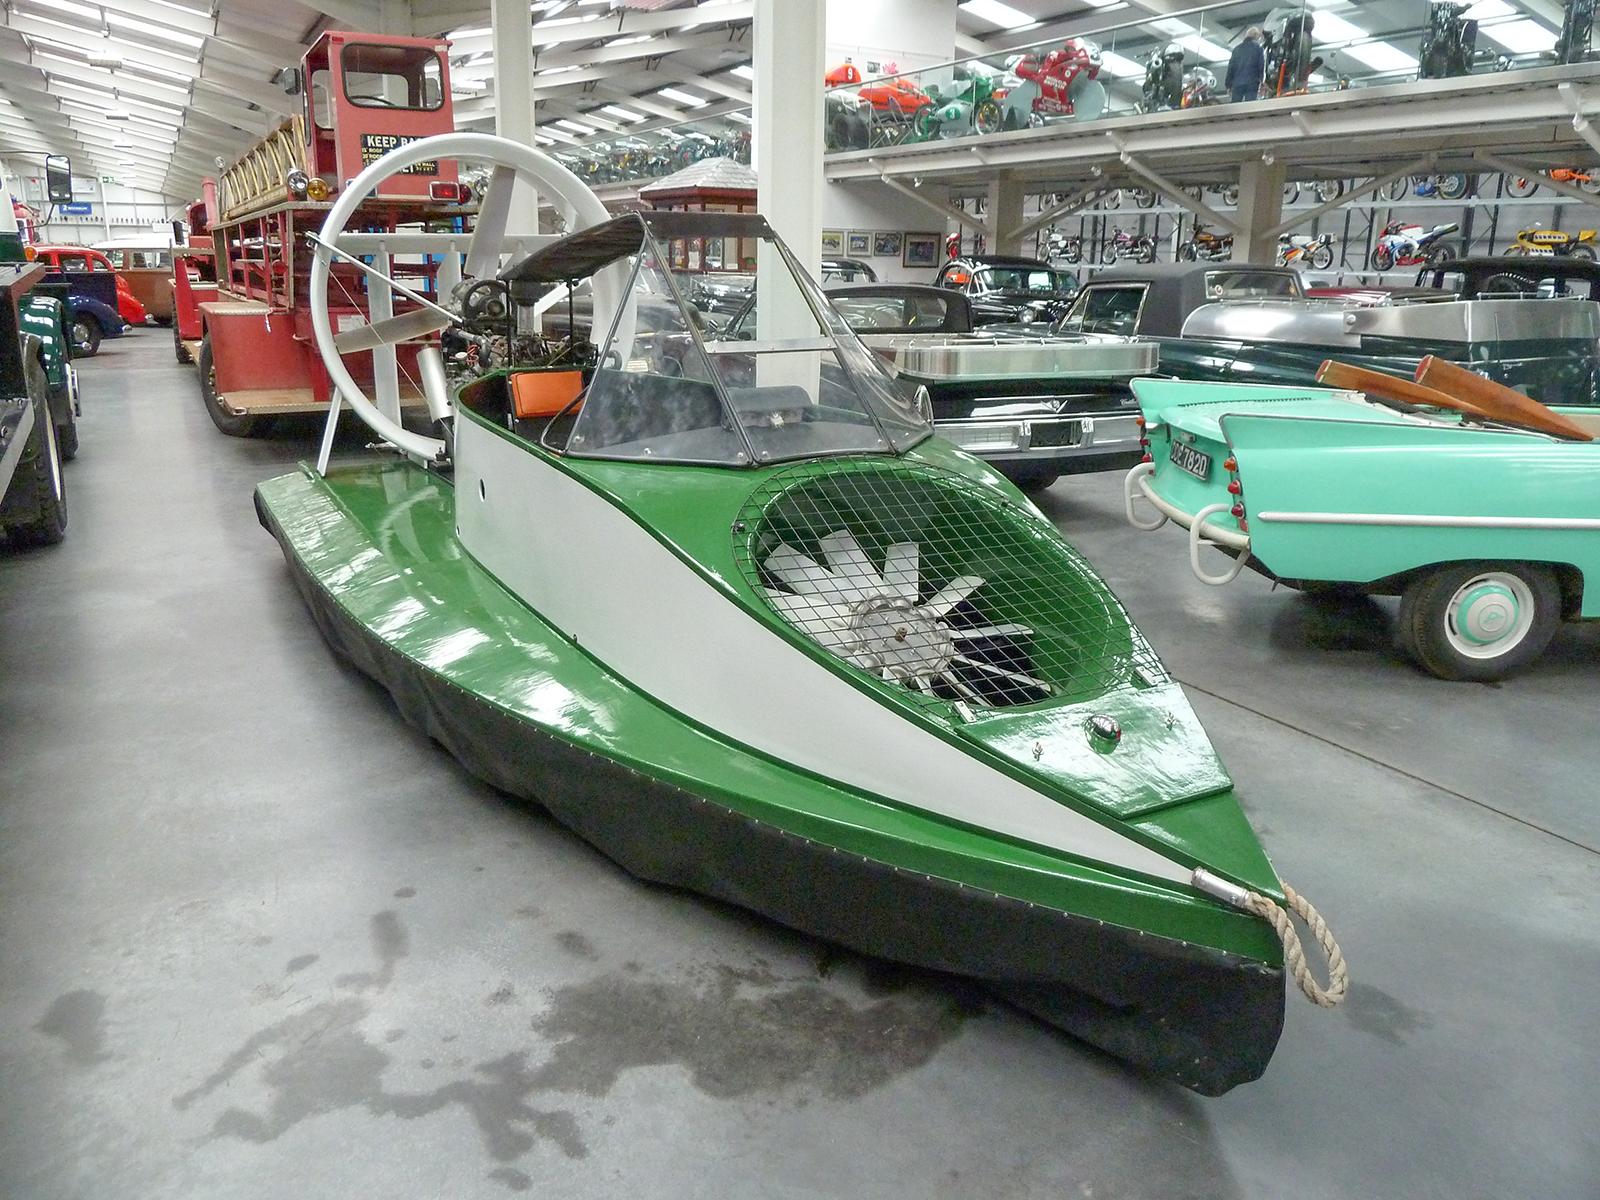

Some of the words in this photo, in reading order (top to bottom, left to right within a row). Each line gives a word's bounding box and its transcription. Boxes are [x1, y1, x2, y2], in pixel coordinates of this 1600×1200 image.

[847, 67, 853, 80] 9
[367, 135, 397, 148] KEEP
[1183, 447, 1207, 476] 782D
